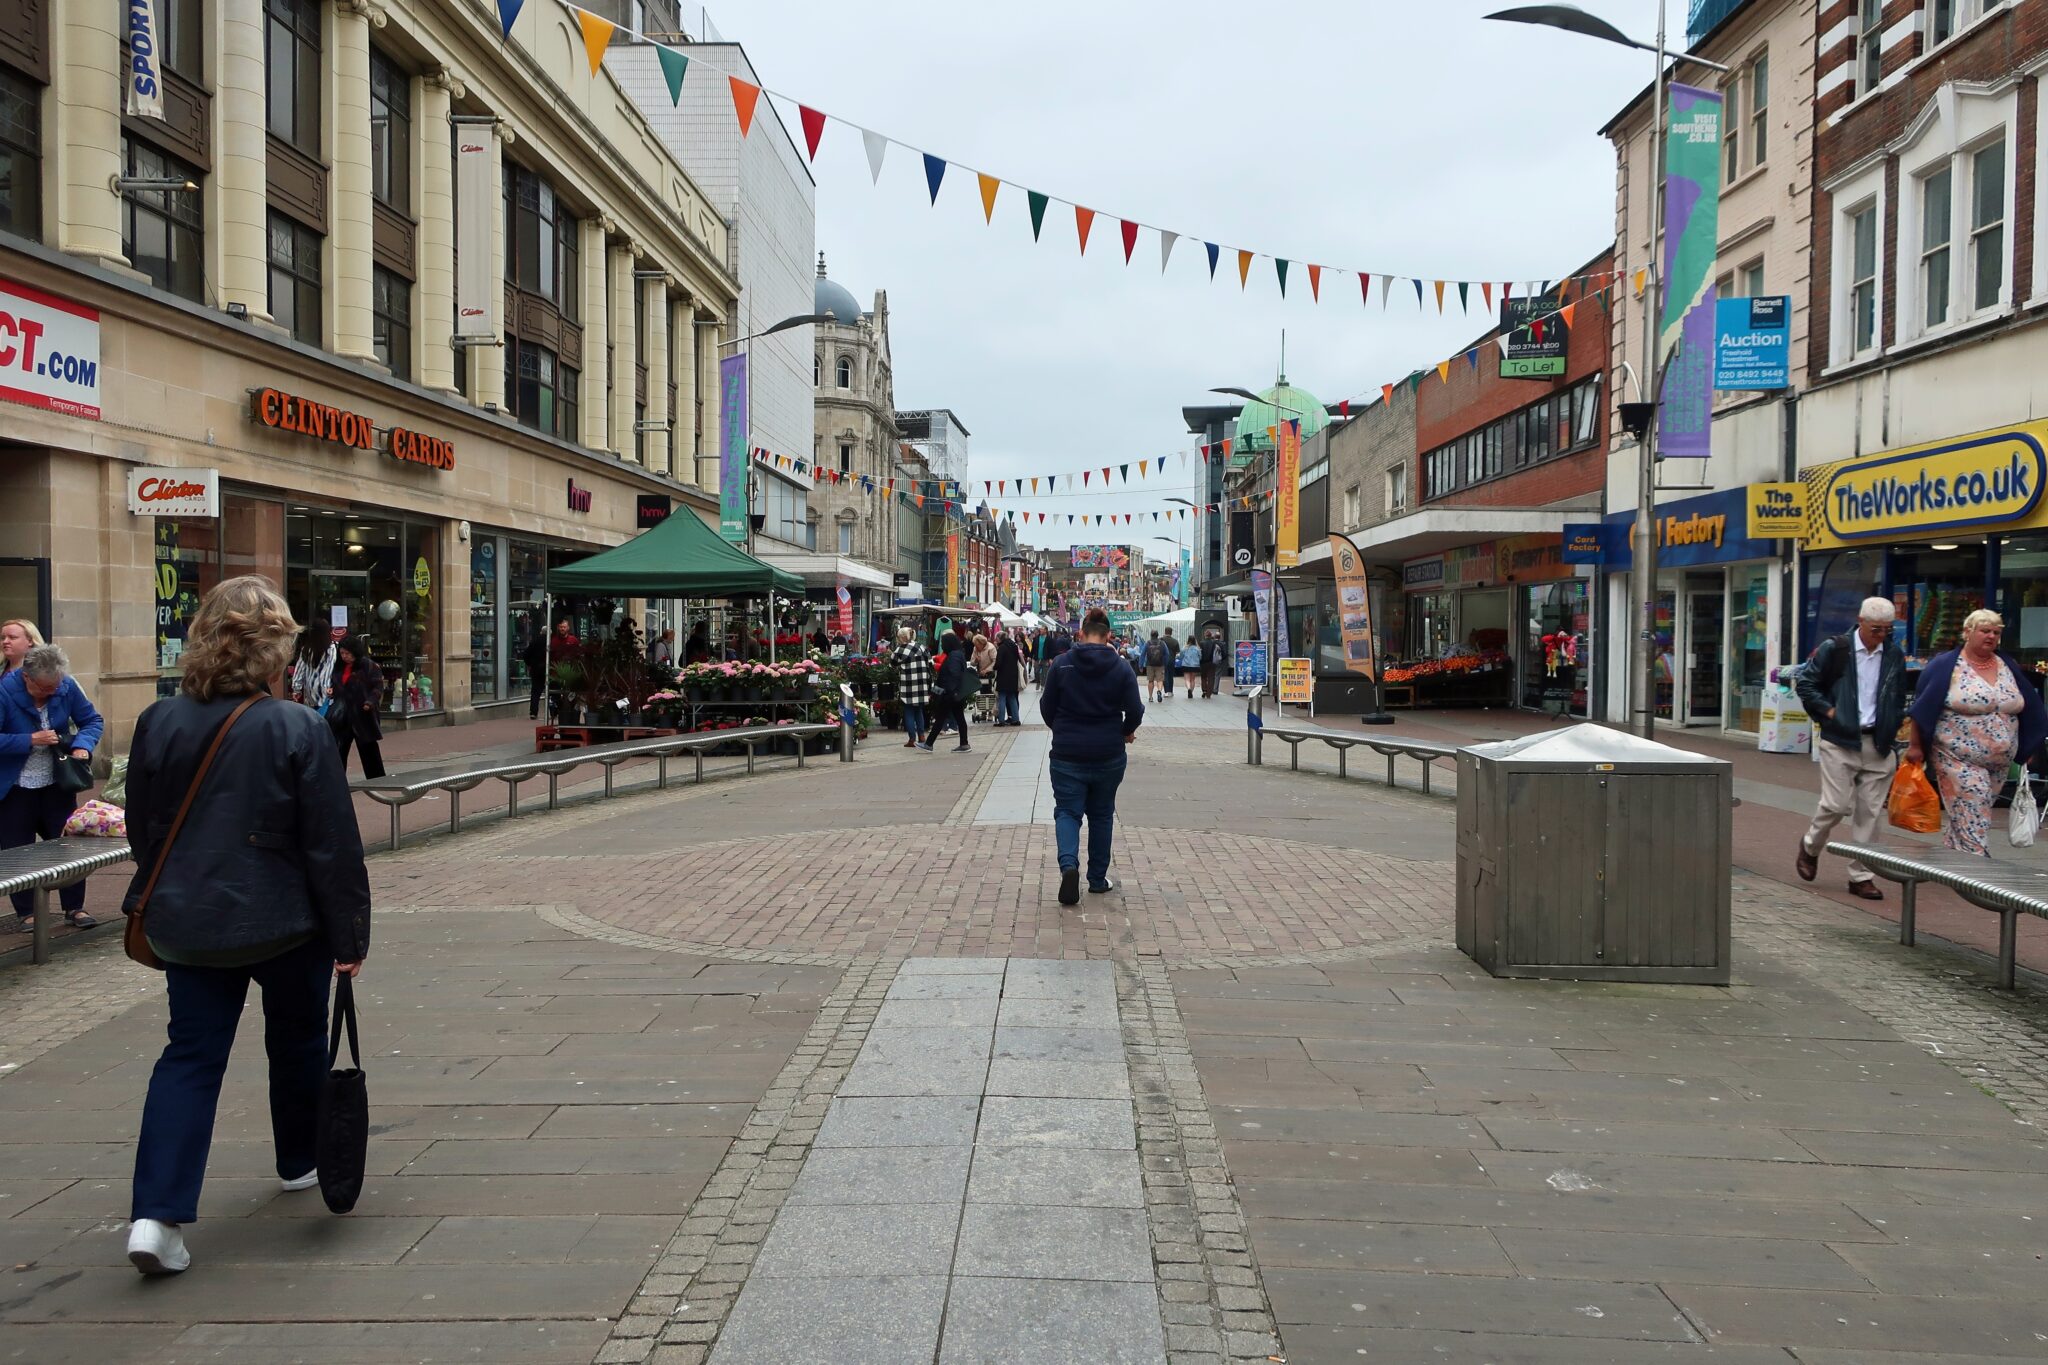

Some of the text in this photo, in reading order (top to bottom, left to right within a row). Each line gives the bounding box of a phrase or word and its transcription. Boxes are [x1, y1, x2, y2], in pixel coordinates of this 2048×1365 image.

[1694, 114, 1717, 124] VISIT
[1672, 123, 1717, 134] SOUTHEND
[1753, 298, 1782, 306] Barnett
[1720, 332, 1782, 347] Auction
[1510, 361, 1555, 372] To Let
[1737, 370, 1759, 378] 8492
[49, 397, 79, 413] Temporary
[260, 387, 455, 471] CLINTON CARDS
[138, 478, 205, 502] Clinton
[1835, 452, 2029, 522] TheWorks.co.uk
[567, 478, 592, 513] hmv
[1765, 490, 1793, 503] The
[641, 506, 666, 517] hmv
[1756, 504, 1803, 519] Works
[1666, 512, 1726, 548] Factory
[1575, 536, 1596, 544] Card
[1568, 543, 1601, 552] Factory
[1238, 552, 1249, 561] JD
[1422, 562, 1440, 579] STATION
